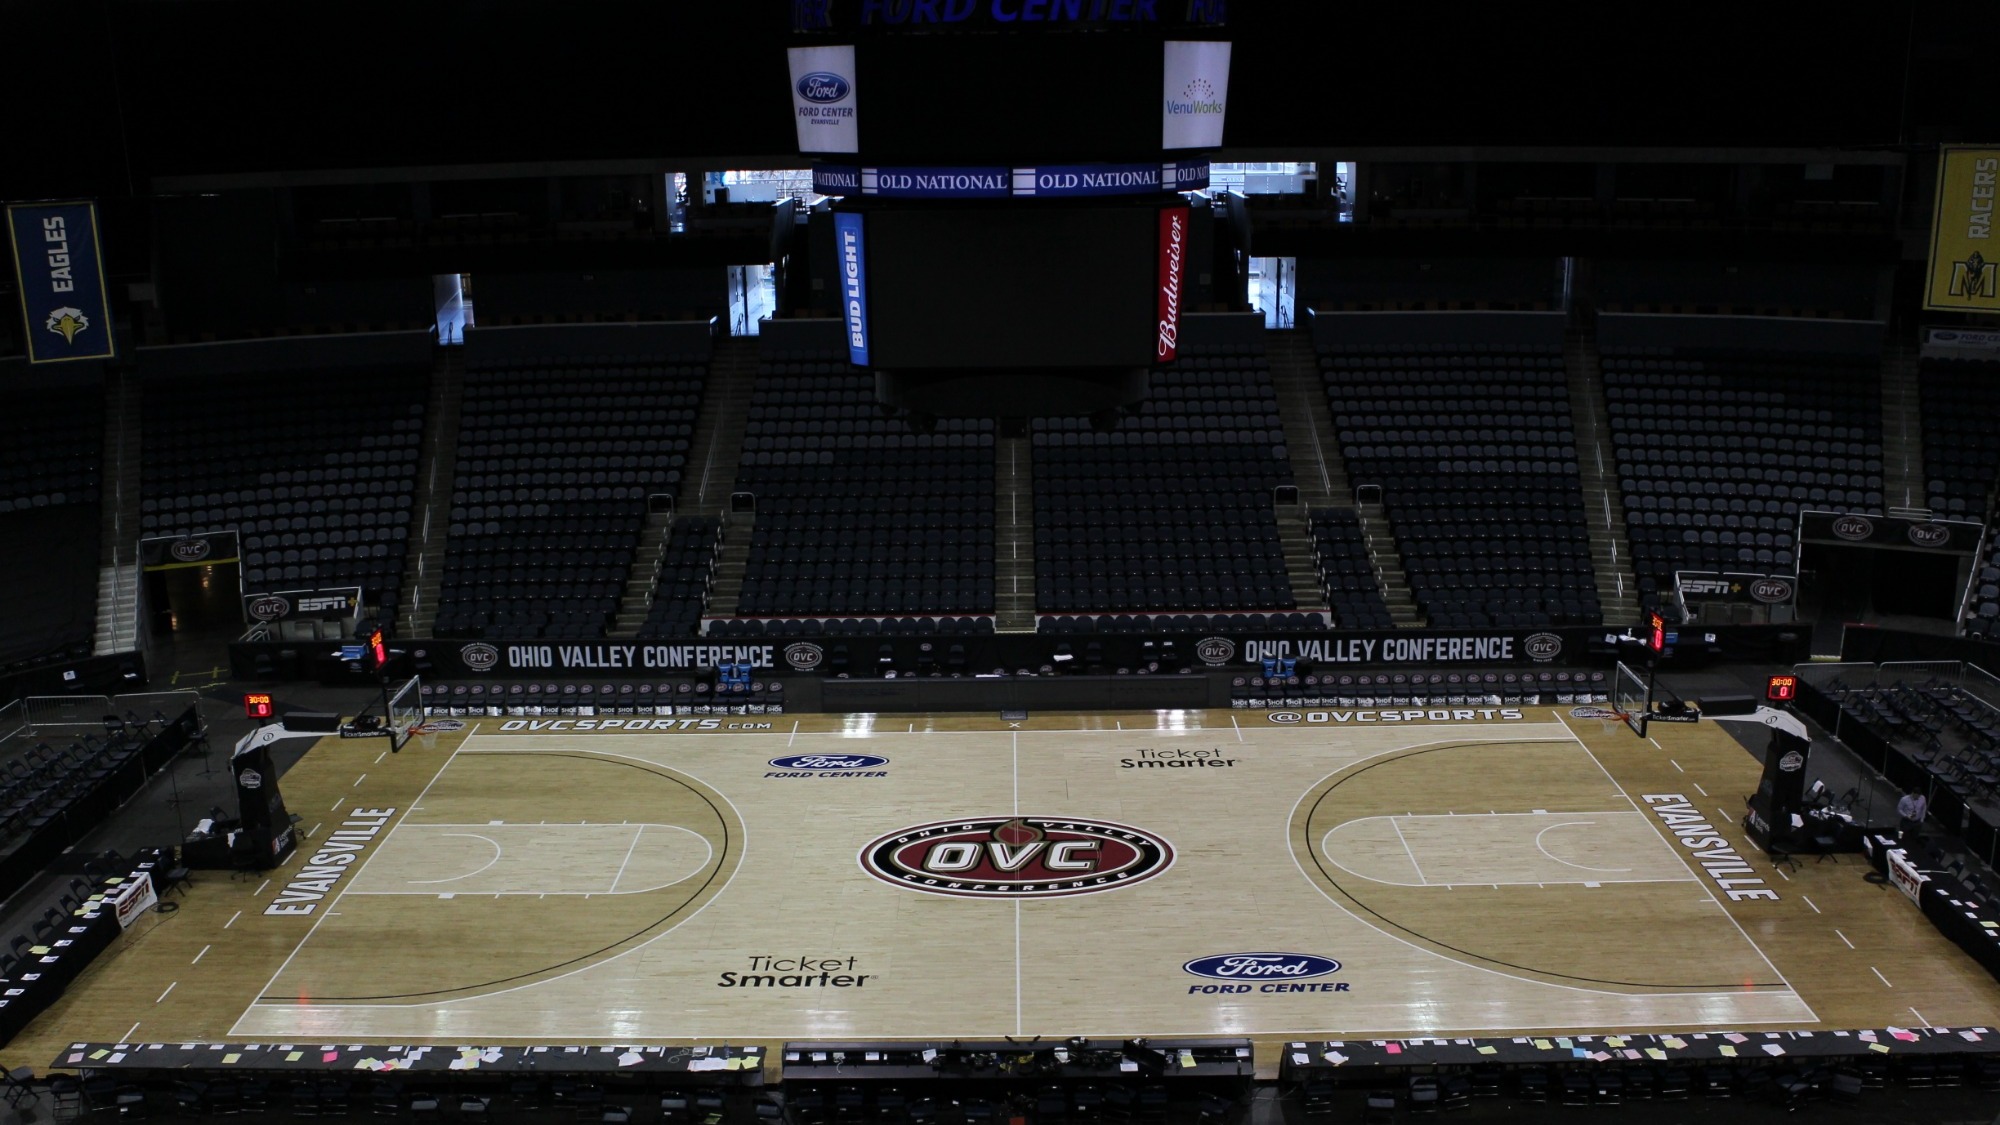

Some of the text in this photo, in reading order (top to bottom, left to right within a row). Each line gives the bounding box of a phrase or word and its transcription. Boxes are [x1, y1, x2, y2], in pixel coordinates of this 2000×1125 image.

[806, 76, 839, 98] Ford
[799, 107, 854, 118] FORD CENTER
[1166, 99, 1223, 115] VenuWorks
[818, 173, 859, 188] NATIONAL
[879, 174, 1008, 190] OLD NATIONAL
[1039, 170, 1159, 189] OLD NATIONAL
[1177, 167, 1196, 182] OLD
[1967, 157, 1999, 239] RACERS
[42, 216, 74, 293] EAGLES
[844, 231, 864, 348] BUD LIGHT
[1157, 214, 1182, 357] Budweiser
[1841, 523, 1864, 534] OVC
[1916, 530, 1941, 540] OVC
[179, 545, 201, 554] OVC
[508, 645, 553, 668] OHIO
[558, 645, 637, 668] VALLEY
[642, 645, 775, 668] CONFERENCE
[1245, 640, 1291, 663] OHIO
[1297, 639, 1377, 663] VALLEY
[1382, 636, 1515, 661] CONFERENCE
[1771, 678, 1793, 686] 30:00
[1780, 686, 1789, 697] 0
[248, 696, 270, 704] 30:00
[257, 704, 267, 715] 0
[1267, 708, 1524, 724] @OVCSPORTS
[791, 755, 866, 768] Ford
[1136, 748, 1222, 759] Ticket
[1120, 758, 1236, 769] Smarter
[897, 822, 1152, 847] OHIO VALLEY
[1640, 793, 1781, 901] EVANSVILLE
[262, 807, 397, 916] EVANSVILLE
[926, 840, 1097, 871] OVC
[902, 871, 1129, 892] CONFERENCE
[118, 878, 150, 918] ESPN
[749, 955, 858, 972] Ticket
[1215, 956, 1309, 976] Ford
[716, 971, 871, 988] Smarter
[1187, 982, 1351, 995] FORD CENTER
